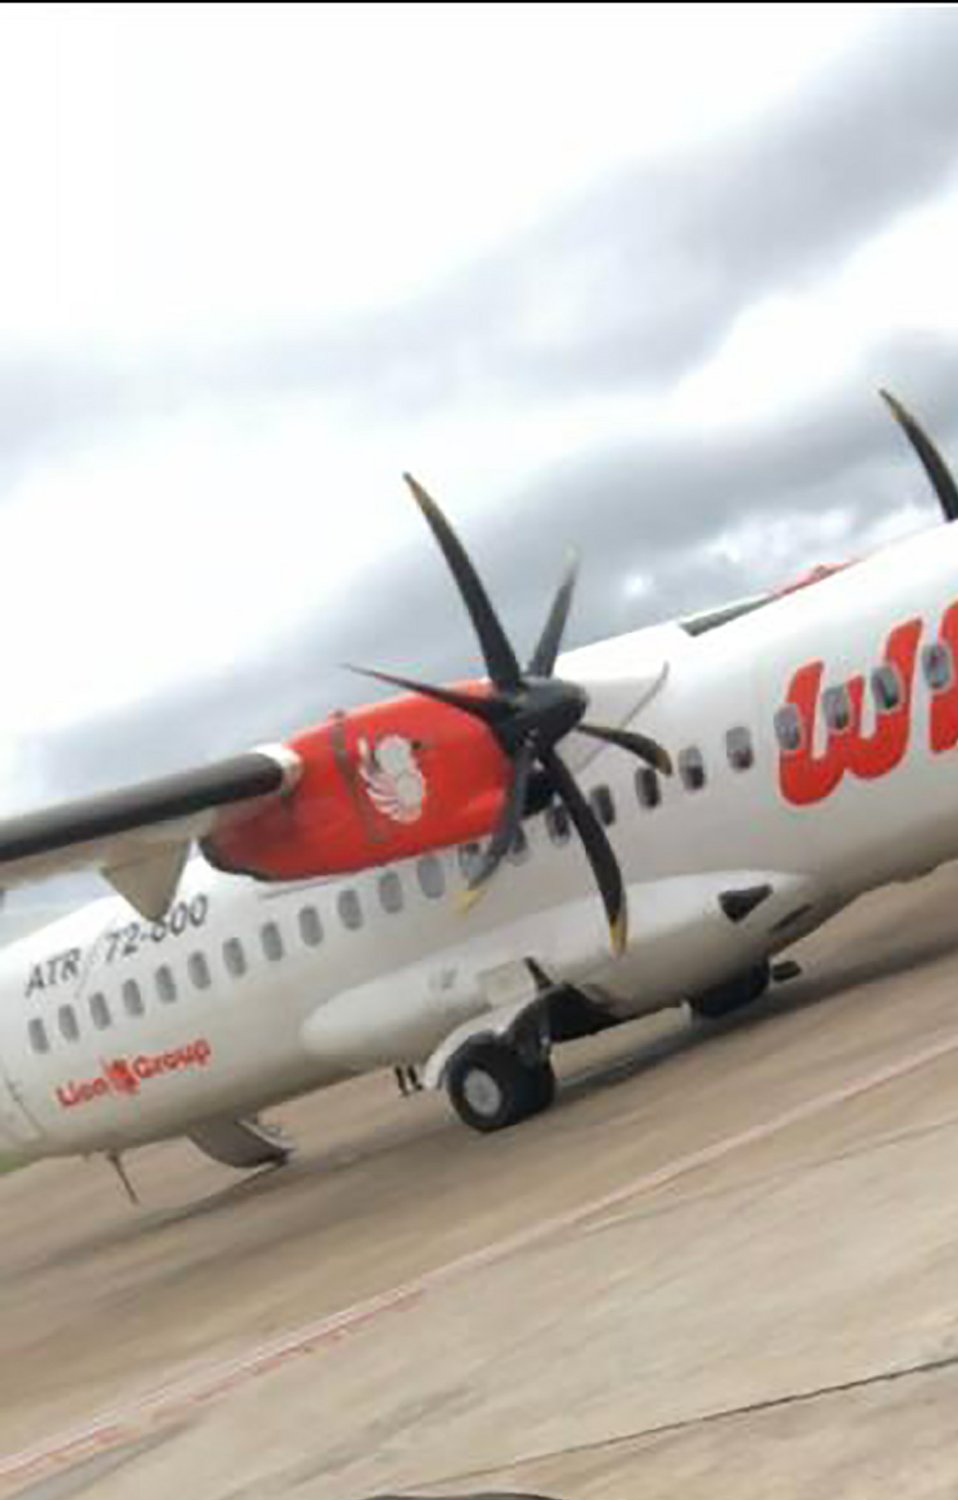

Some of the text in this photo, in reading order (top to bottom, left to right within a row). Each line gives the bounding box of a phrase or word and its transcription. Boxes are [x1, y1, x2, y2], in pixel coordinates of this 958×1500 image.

[25, 947, 81, 998] ATR
[55, 1038, 212, 1108] Lion Group
